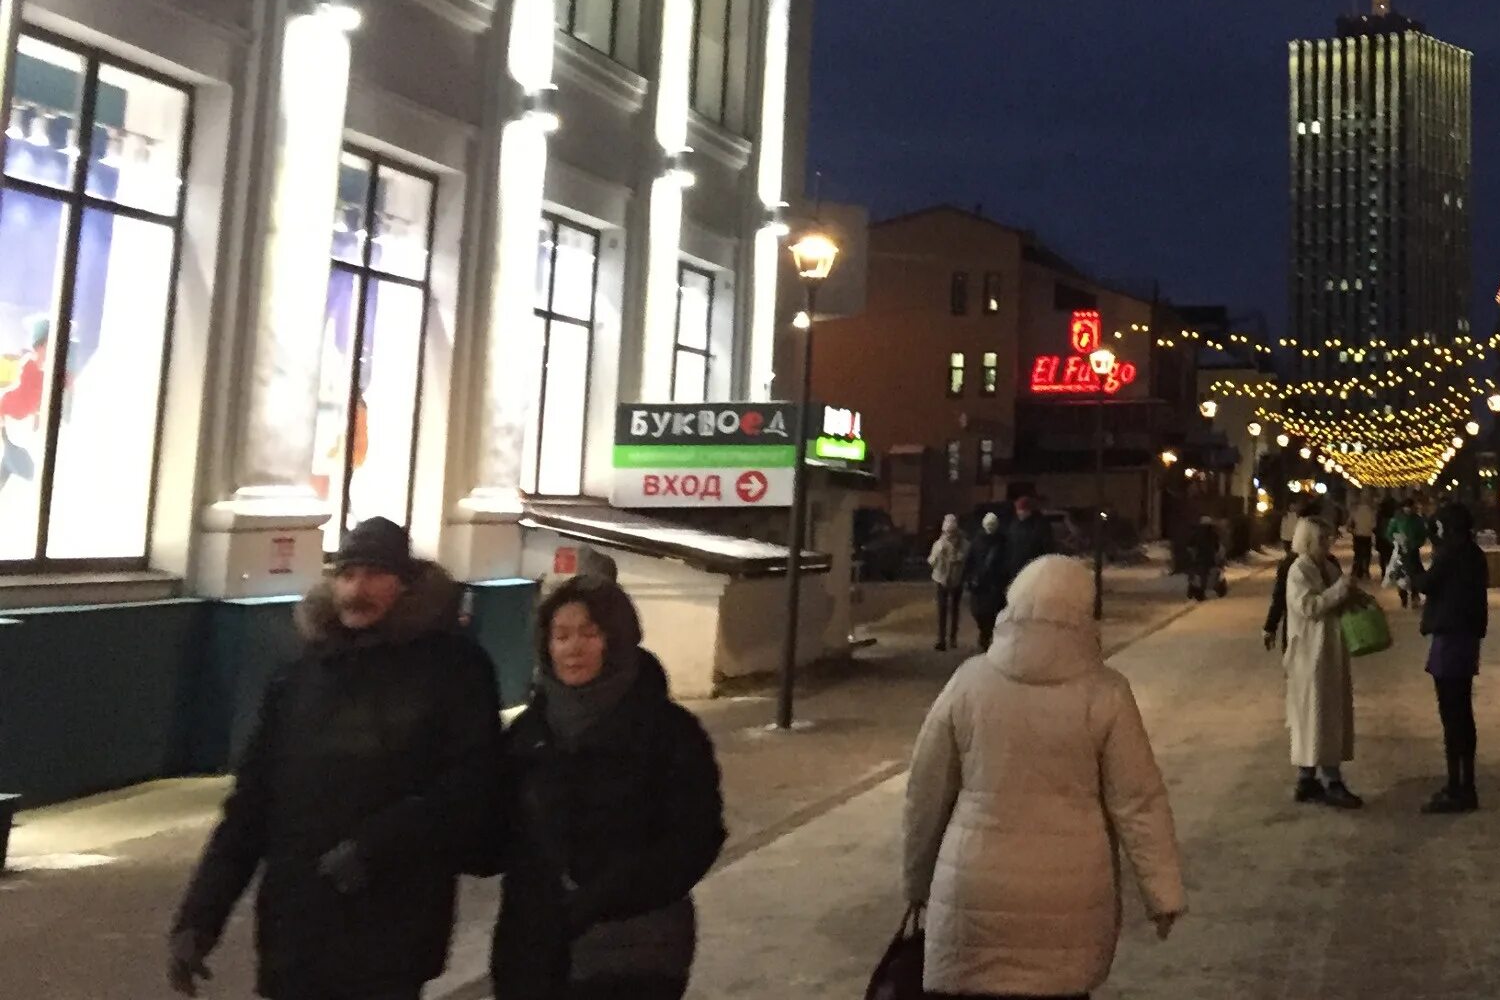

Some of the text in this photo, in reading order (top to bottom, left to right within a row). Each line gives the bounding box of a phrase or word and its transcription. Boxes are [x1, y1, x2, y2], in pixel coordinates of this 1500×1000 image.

[1032, 355, 1136, 394] El Fugo
[643, 474, 722, 500] ВХОД
